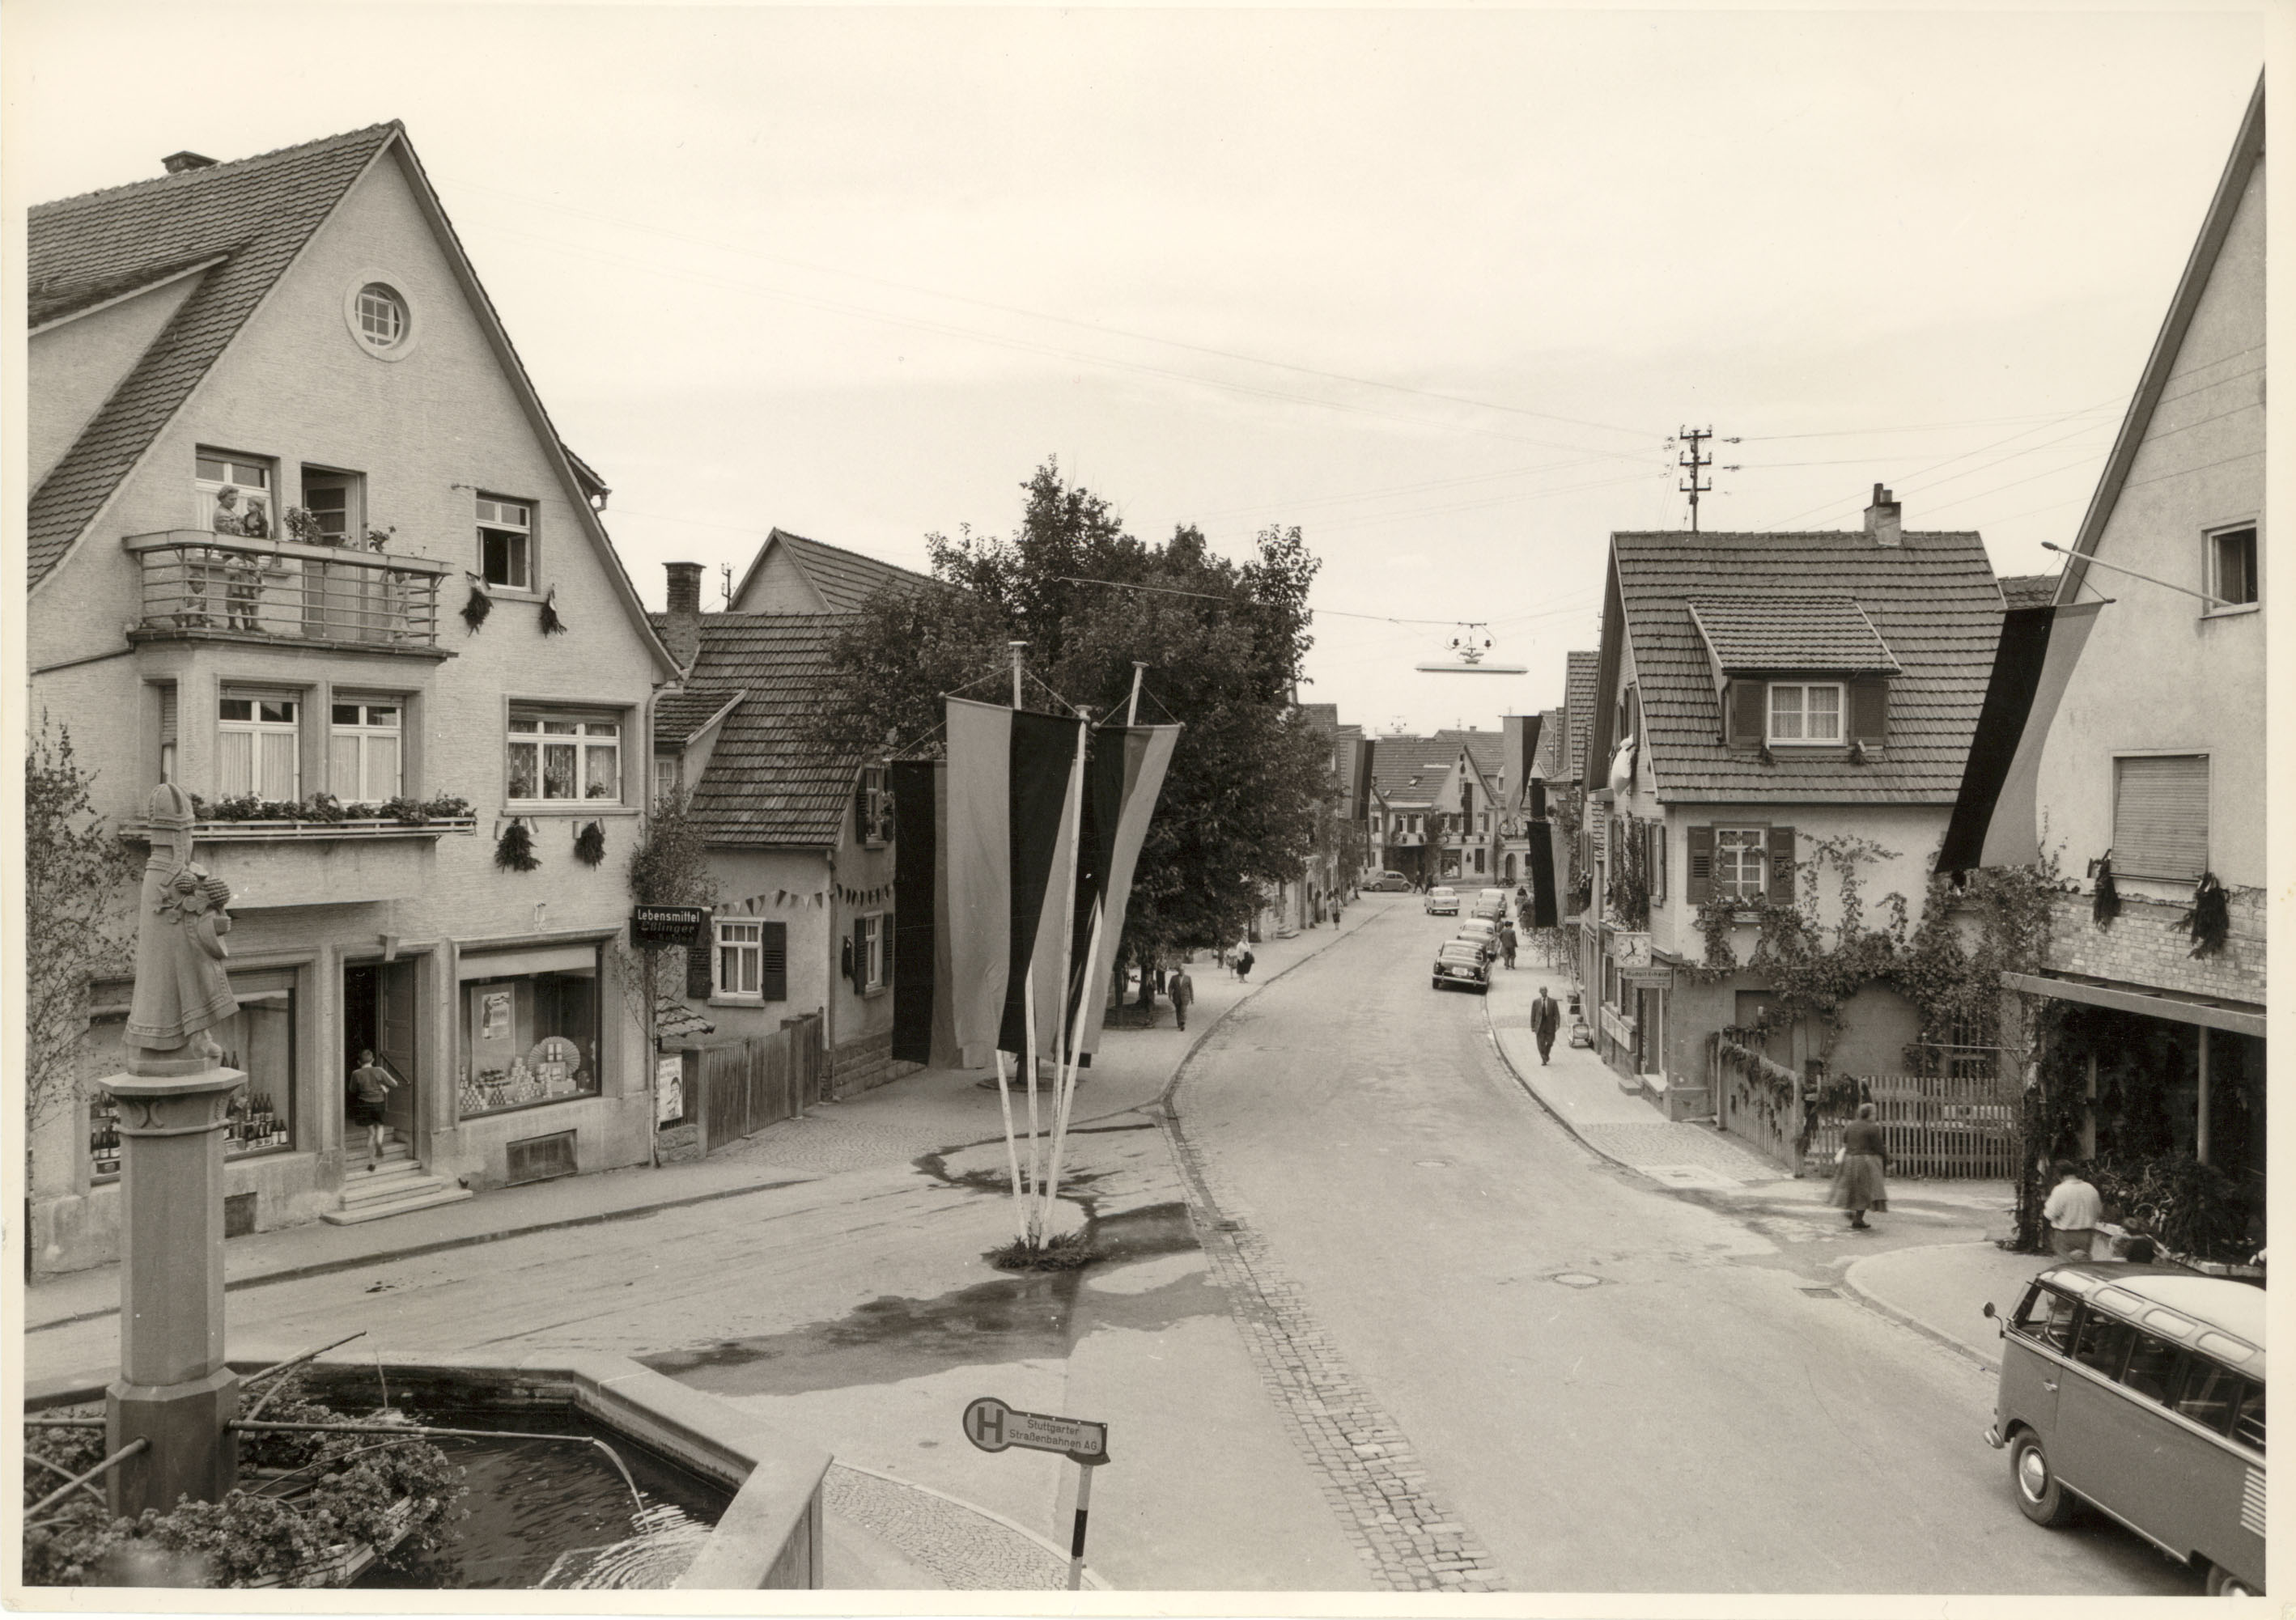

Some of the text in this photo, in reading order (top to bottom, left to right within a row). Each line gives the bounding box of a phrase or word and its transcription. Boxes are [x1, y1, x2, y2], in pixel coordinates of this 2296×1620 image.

[638, 909, 700, 922] Lebensmittel
[977, 1406, 1004, 1444] H
[1027, 1419, 1080, 1436] Stuttgarter
[1009, 1429, 1097, 1450] Straßenbahnen AG
